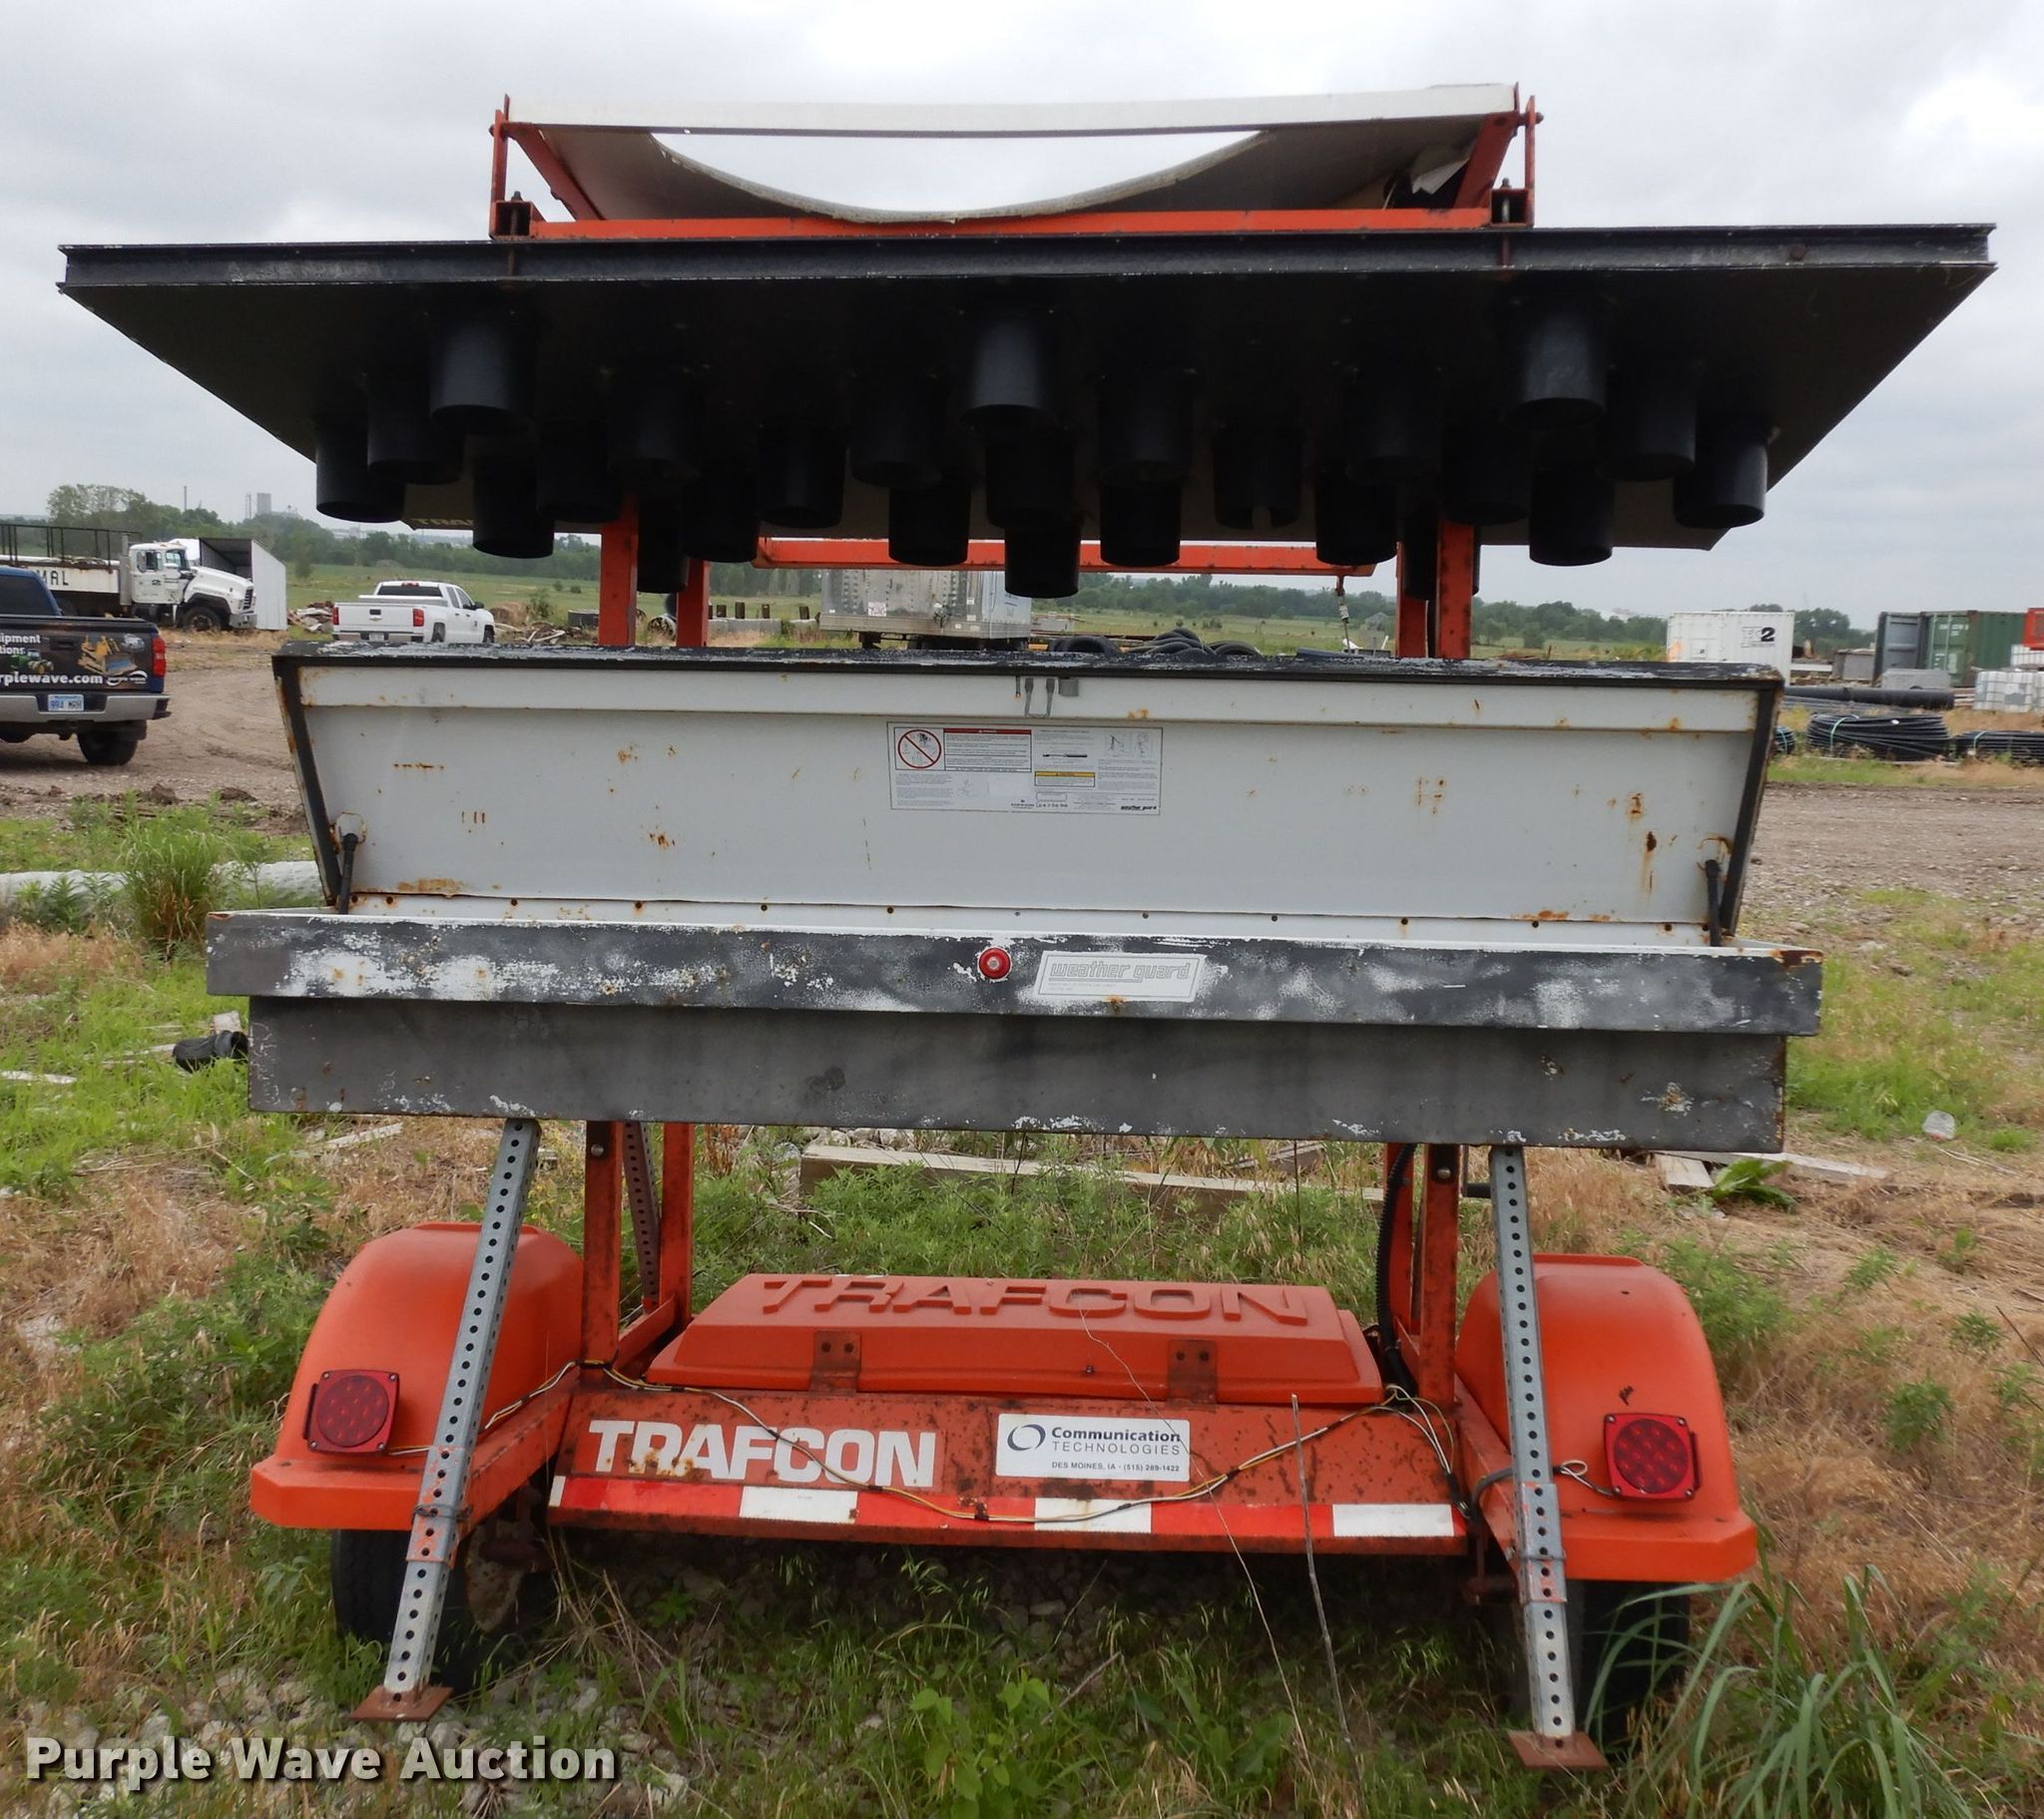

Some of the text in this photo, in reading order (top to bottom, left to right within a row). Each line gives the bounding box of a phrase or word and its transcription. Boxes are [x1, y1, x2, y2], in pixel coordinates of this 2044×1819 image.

[1761, 627, 1776, 642] 2
[1050, 961, 1191, 983] weather guard
[763, 1278, 1307, 1326] TRAFCON
[1051, 1427, 1181, 1442] Communication
[589, 1420, 936, 1488] TRAFCON
[1052, 1441, 1180, 1455] TECHNOLOGIES
[1071, 1462, 1105, 1472] MOINES,
[1123, 1463, 1143, 1472] (515)
